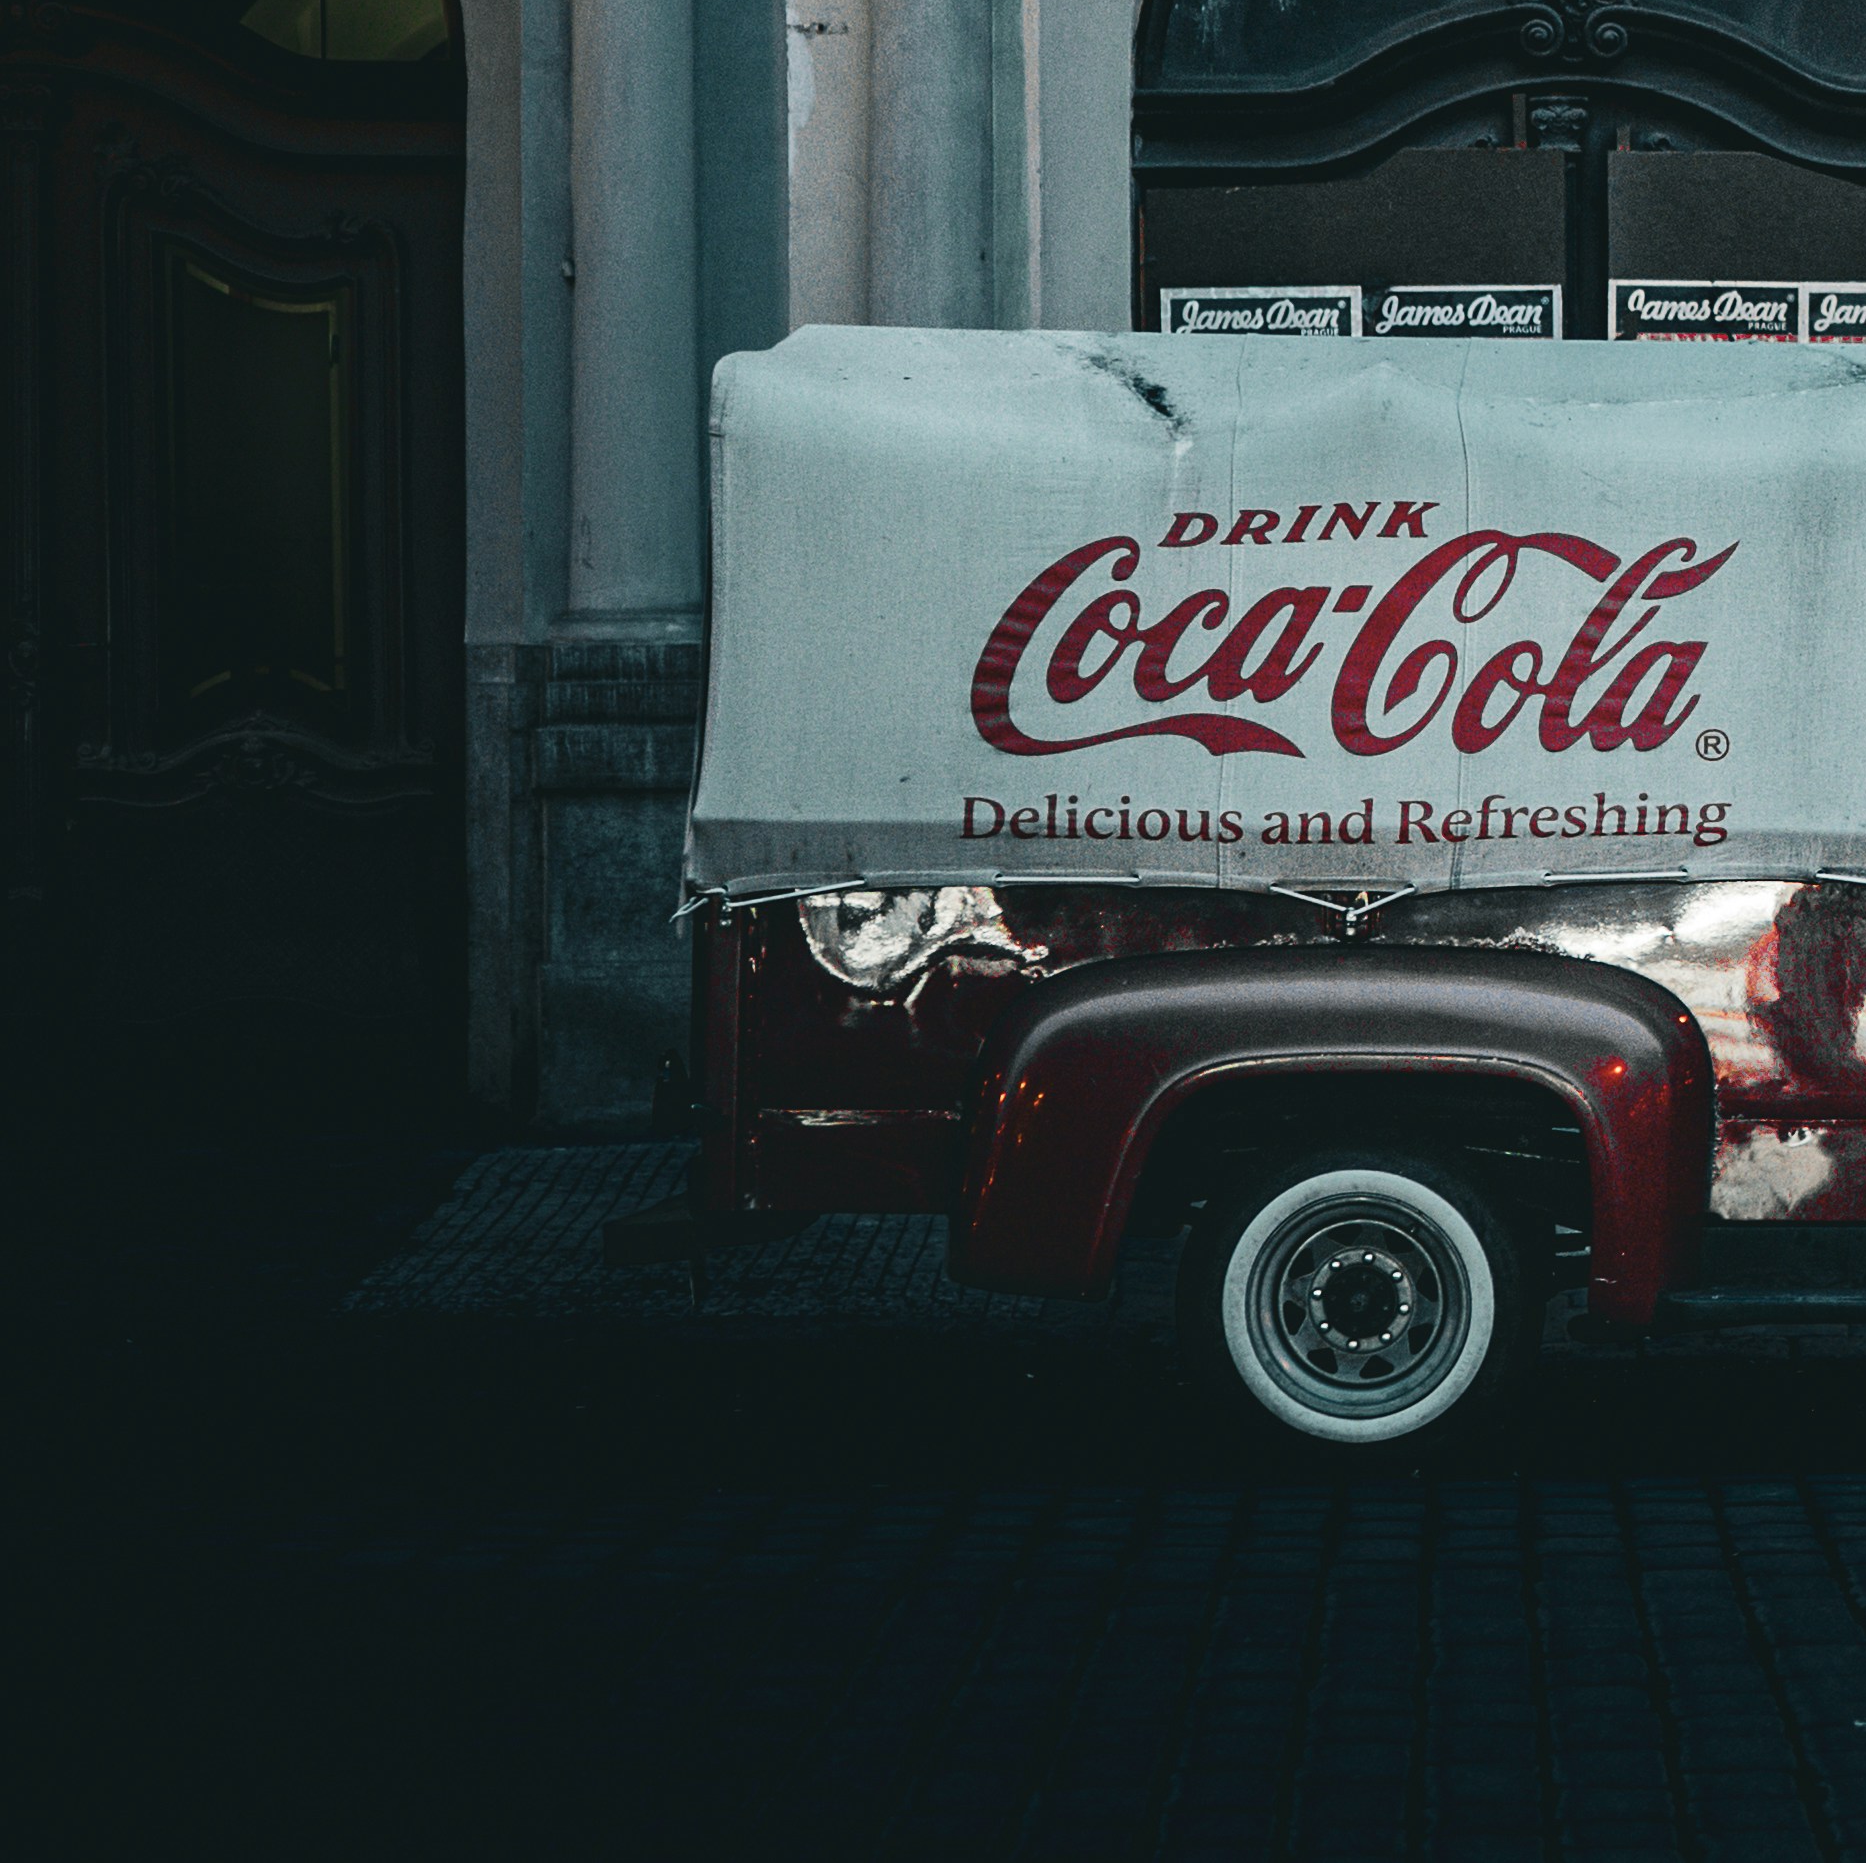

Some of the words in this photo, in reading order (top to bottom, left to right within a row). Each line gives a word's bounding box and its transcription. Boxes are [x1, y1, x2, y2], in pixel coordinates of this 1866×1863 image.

[1176, 299, 1264, 335] James
[1266, 298, 1340, 330] Dean
[1375, 295, 1465, 333] James
[1467, 294, 1542, 326] Dean
[1713, 290, 1787, 323] Dean
[1502, 325, 1542, 333] PRAGUE
[1747, 322, 1787, 331] PRAGUE
[1156, 501, 1441, 548] DRINK
[970, 529, 1740, 759] Coca-Cola
[960, 795, 1244, 846] Delicious
[1262, 798, 1376, 846] and
[1397, 793, 1733, 848] Refreshing
